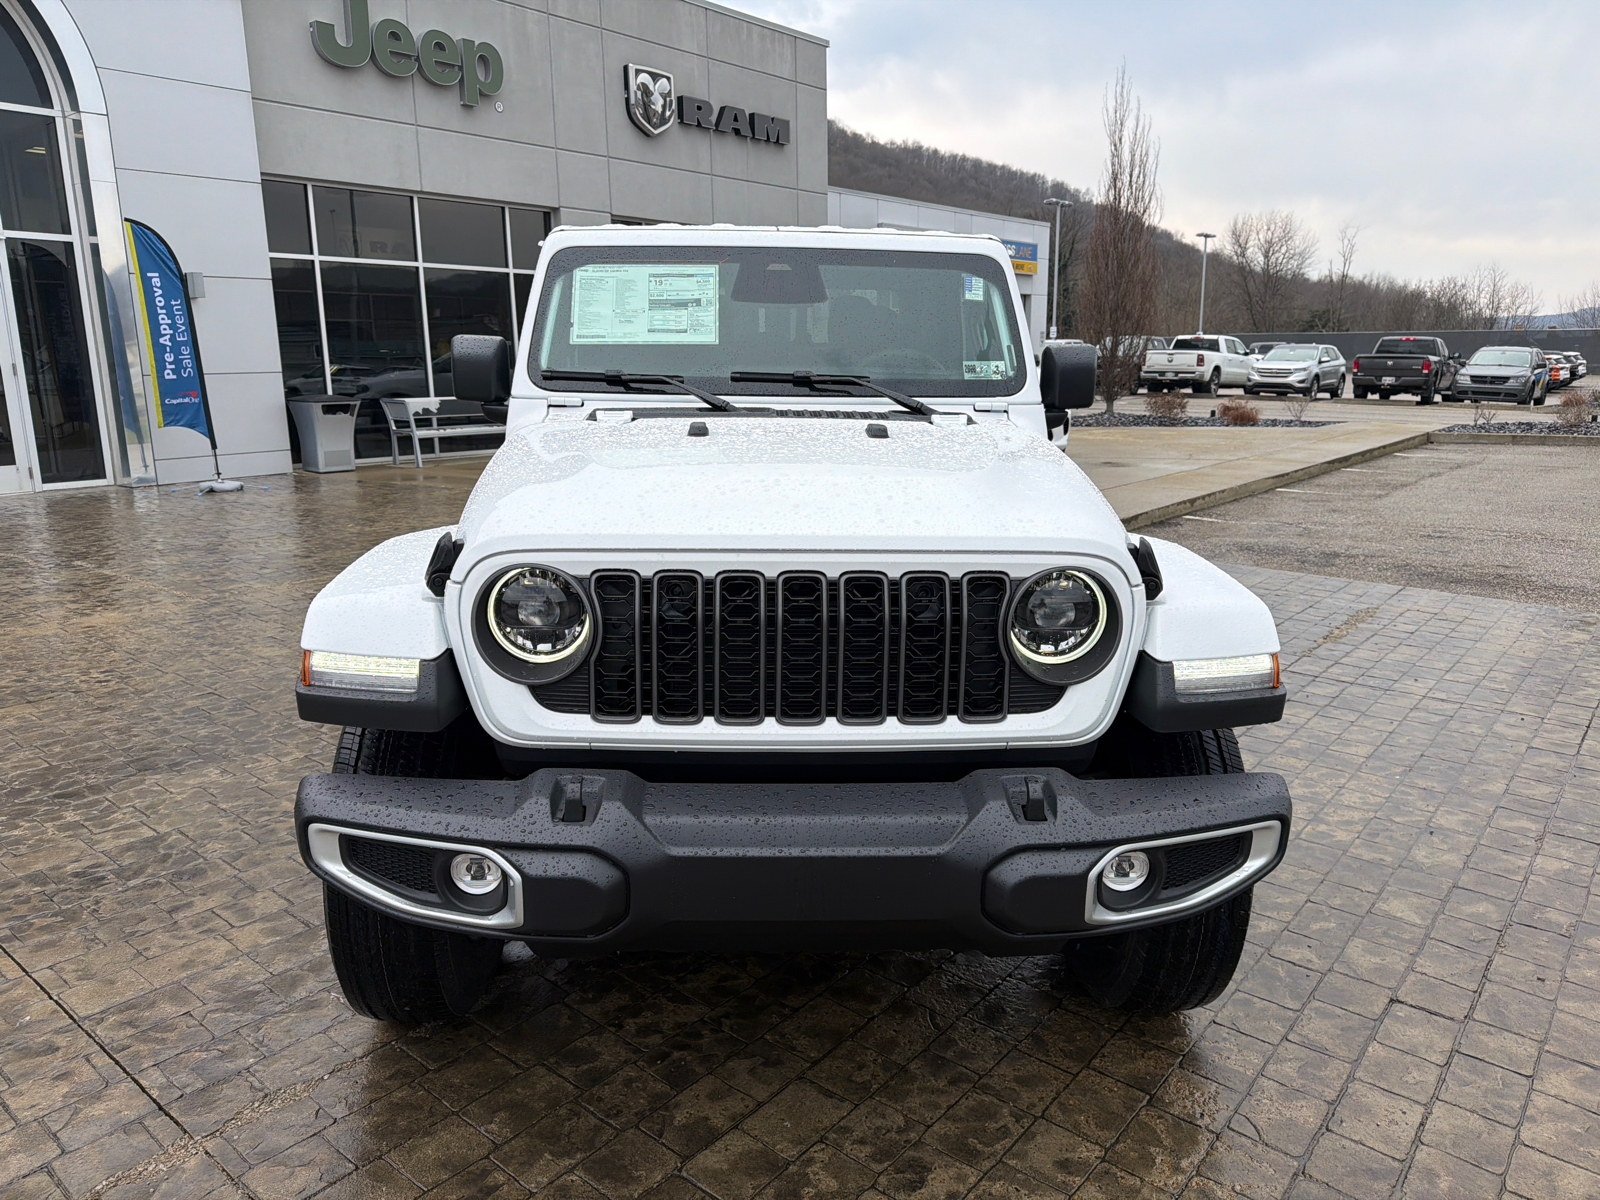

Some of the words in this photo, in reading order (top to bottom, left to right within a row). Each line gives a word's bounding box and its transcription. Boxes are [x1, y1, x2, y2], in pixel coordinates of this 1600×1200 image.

[309, 0, 504, 107] Jeep
[677, 95, 790, 145] RAM
[147, 272, 177, 380] Pre-Approval
[171, 299, 188, 342] Event
[178, 347, 194, 377] Sale
